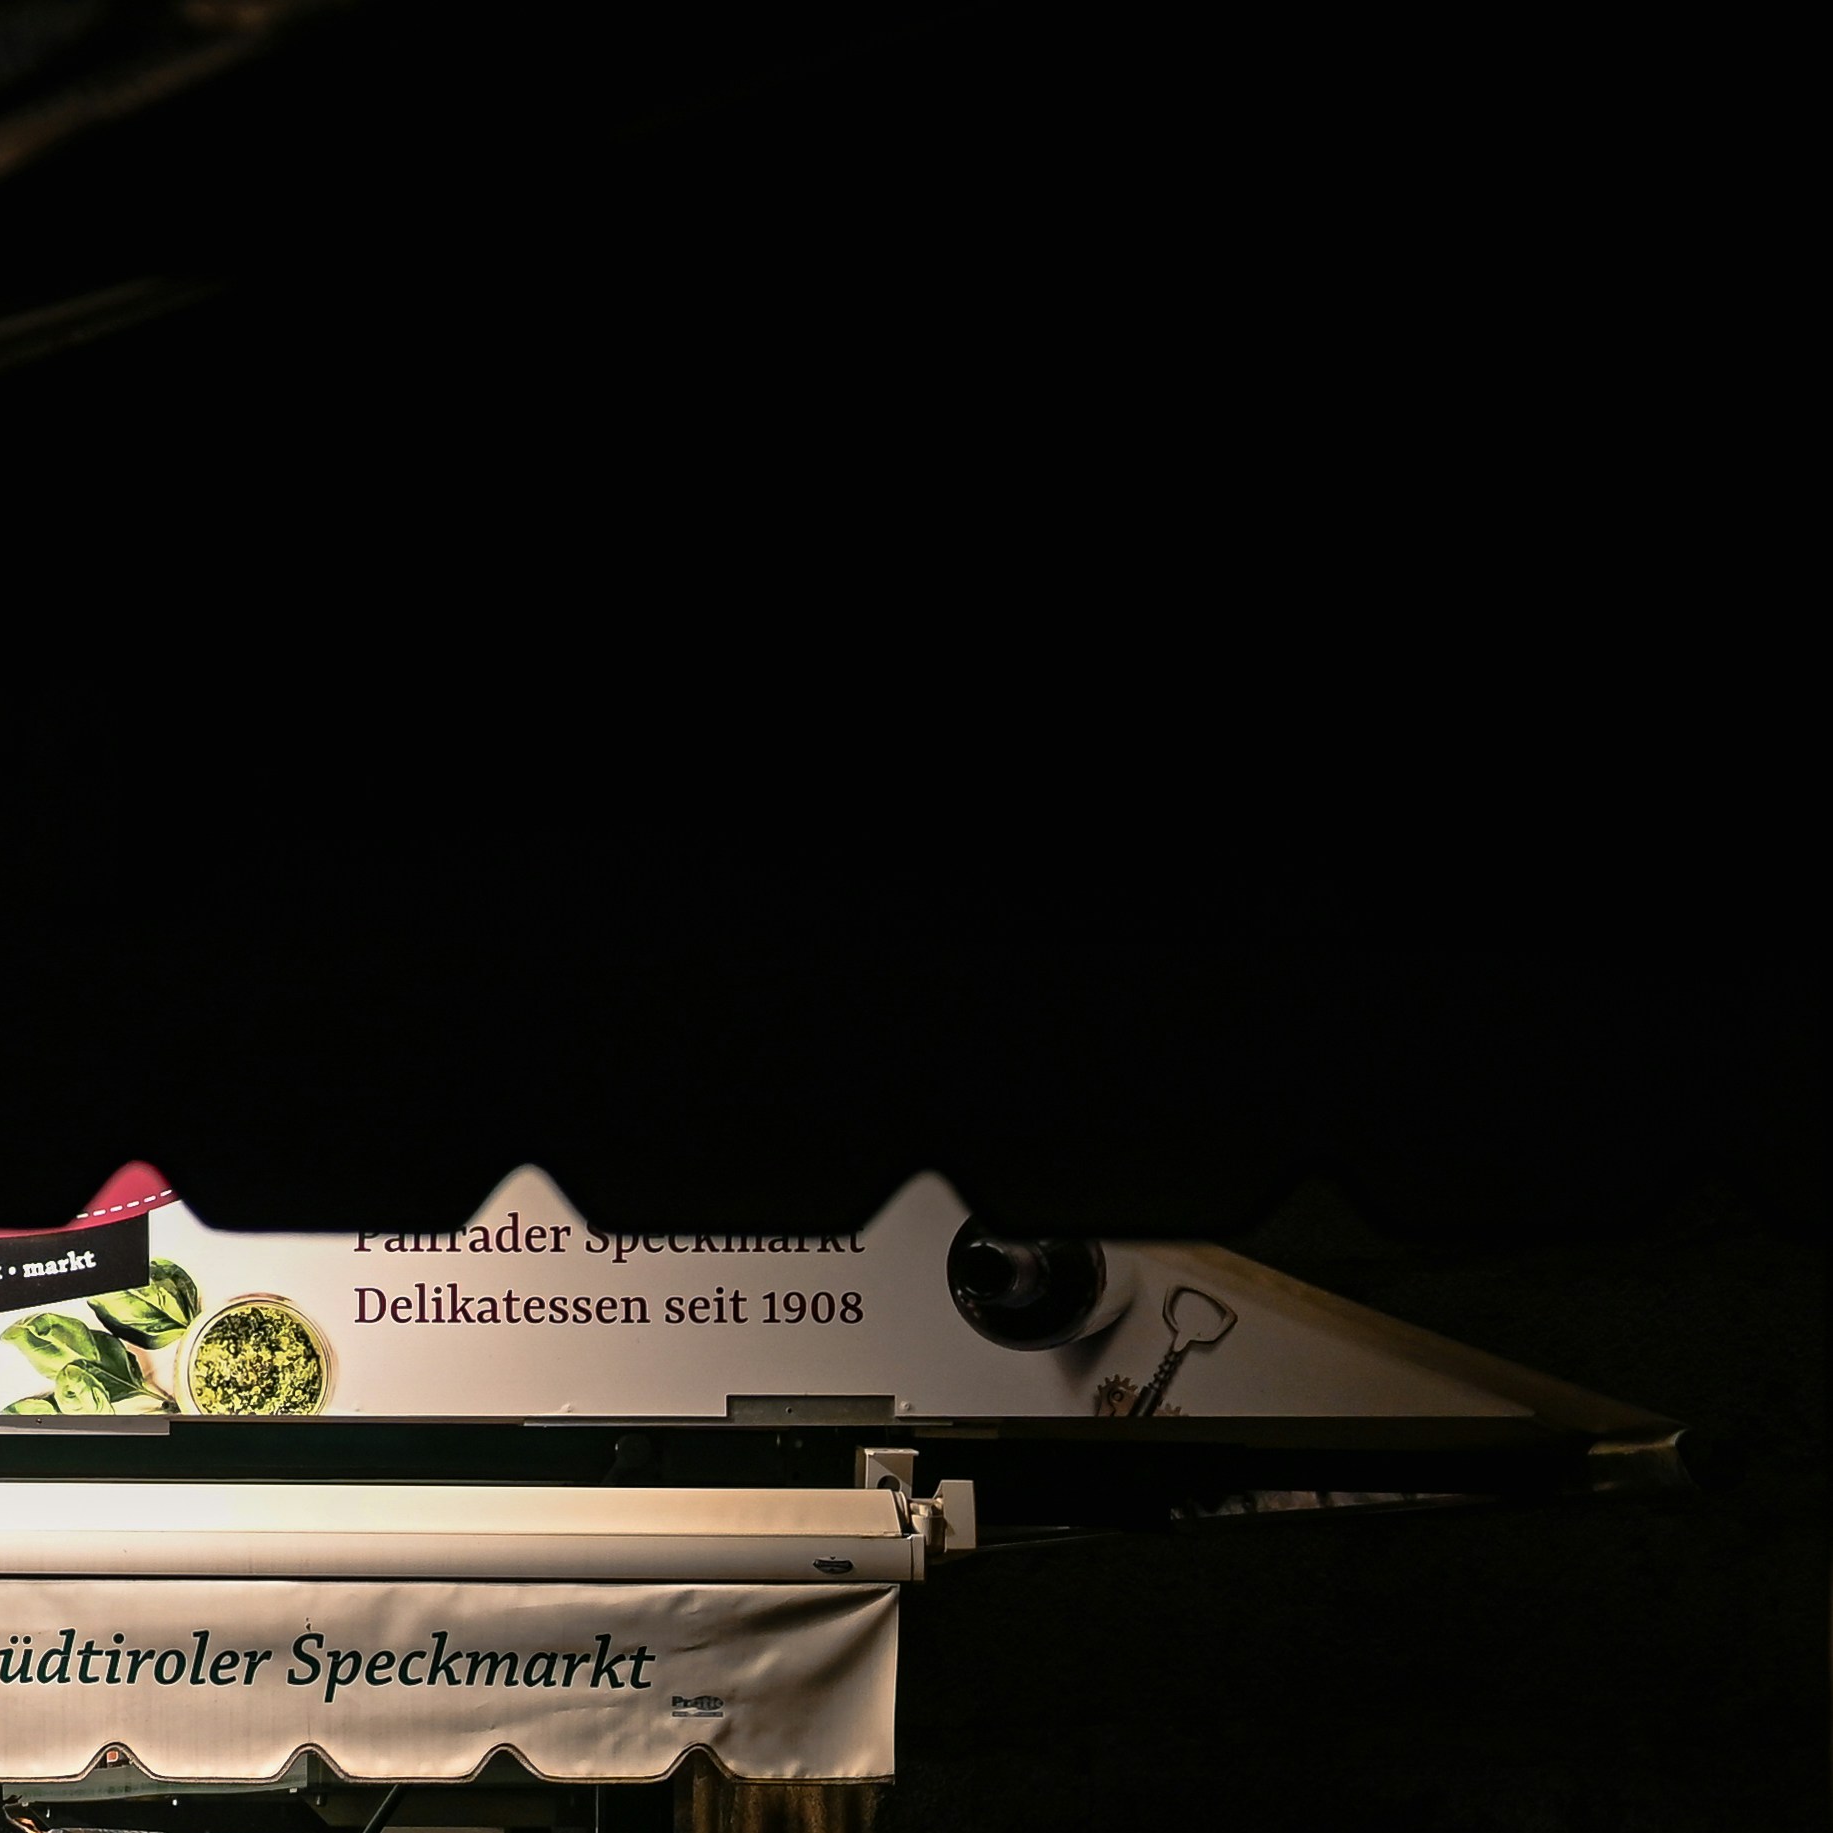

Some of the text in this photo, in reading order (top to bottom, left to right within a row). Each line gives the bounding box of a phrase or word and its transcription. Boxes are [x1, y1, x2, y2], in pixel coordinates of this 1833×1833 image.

[22, 1250, 97, 1278] markt
[354, 1282, 864, 1325] Delikatessen seit 1908
[287, 1632, 656, 1703] Speckmarkt
